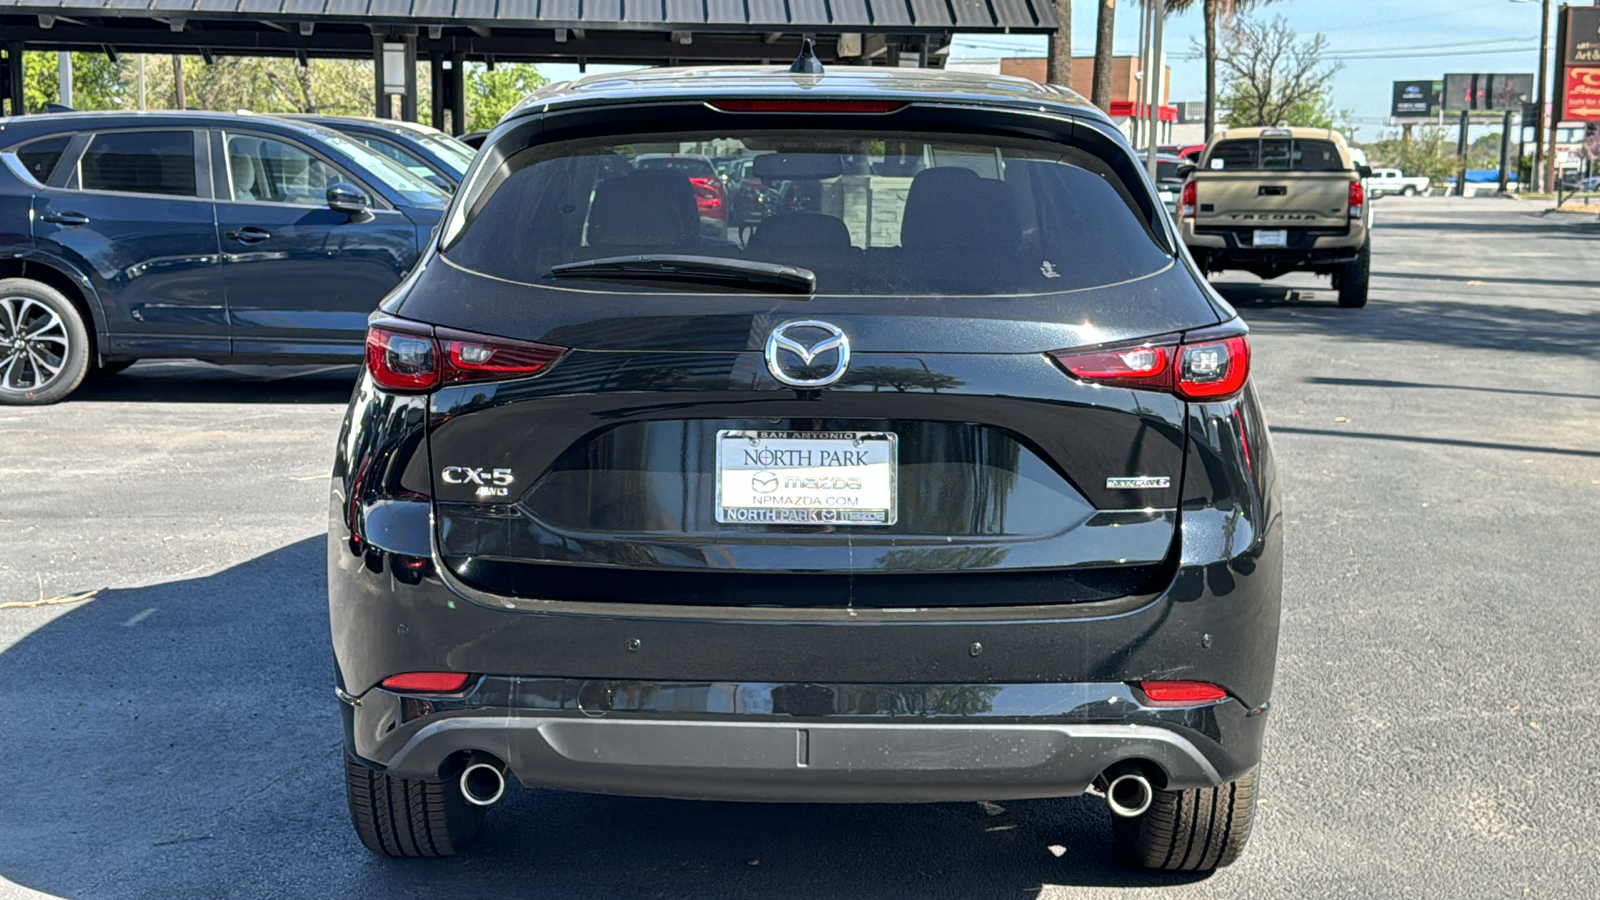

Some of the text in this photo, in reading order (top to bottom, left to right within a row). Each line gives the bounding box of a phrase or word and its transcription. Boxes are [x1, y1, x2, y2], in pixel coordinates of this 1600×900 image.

[1229, 213, 1316, 221] TACOMA
[760, 431, 854, 440] SAN ANTONIO
[743, 448, 869, 467] NORTH PARK
[442, 465, 514, 486] CX-5
[752, 495, 859, 507] NPMAZDACOM
[727, 507, 776, 521] NORTH
[780, 508, 818, 522] PARK
